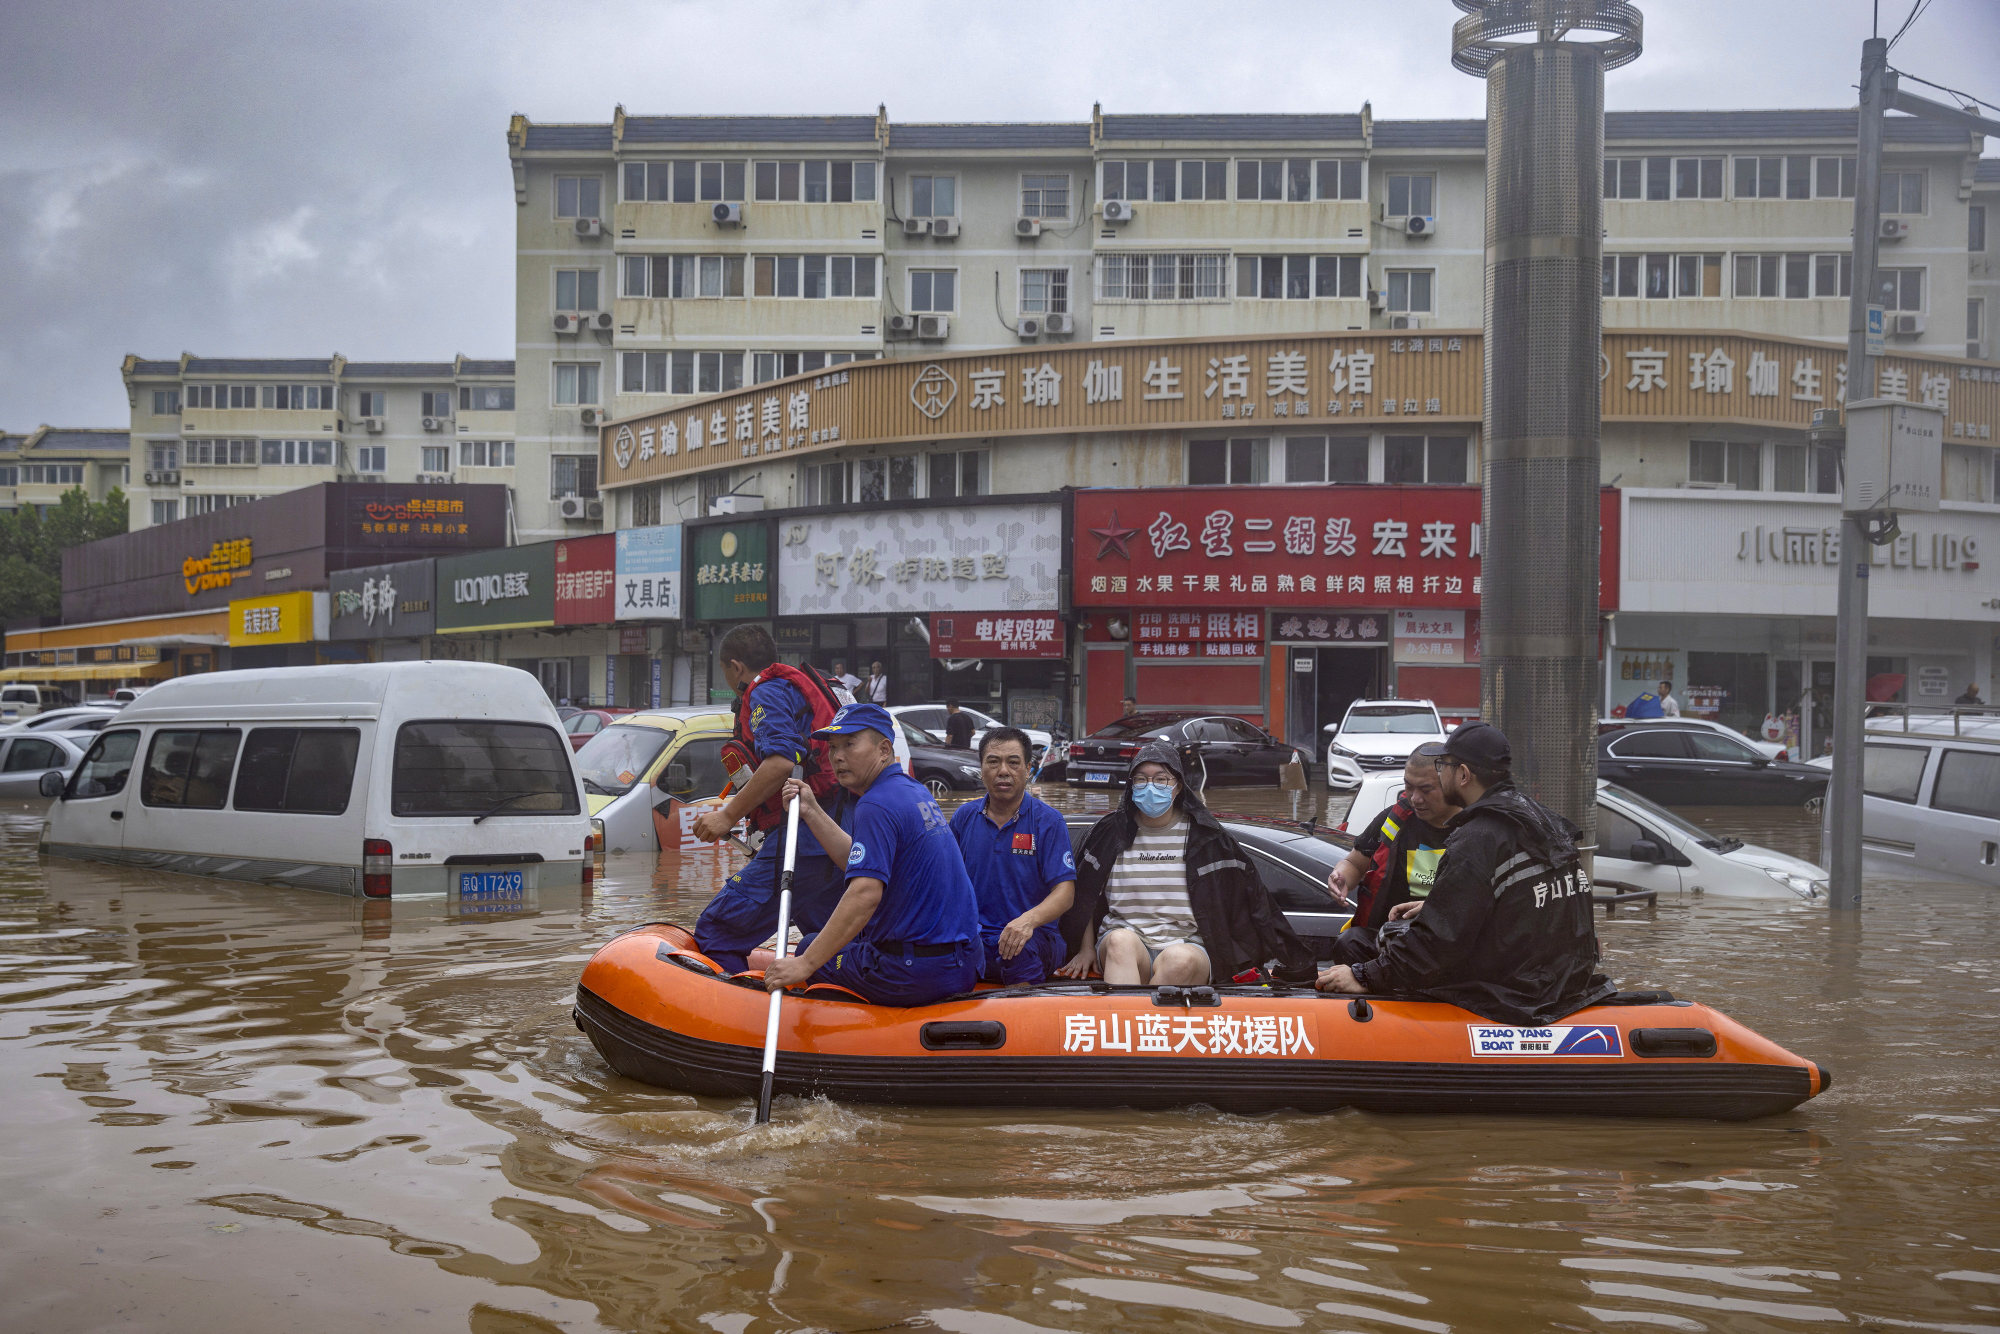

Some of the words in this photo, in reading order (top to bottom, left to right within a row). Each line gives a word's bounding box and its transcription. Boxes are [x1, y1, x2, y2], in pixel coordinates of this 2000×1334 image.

[969, 348, 1375, 411] 京瑜伽生活美馆
[1222, 403, 1256, 418] 理疗
[1273, 401, 1310, 417] 减脂
[1328, 399, 1365, 415] 孕产
[1383, 398, 1441, 414] 普拉提
[638, 390, 811, 461] 京瑜伽生活美馆
[407, 499, 464, 513] 点点超市
[1148, 510, 1357, 559] 红星二锅头
[1372, 518, 1482, 560] 宏来
[624, 577, 671, 608] 文具店
[1091, 575, 1127, 593] 烟酒
[1136, 575, 1173, 593] 水果
[1183, 574, 1220, 593] 干果
[1230, 575, 1268, 593] 礼品
[1277, 574, 1317, 593] 熟食
[1326, 575, 1366, 594] 鲜肉
[1374, 575, 1414, 594] 照相
[1139, 613, 1162, 625] 打印
[1168, 612, 1202, 624] 洗照片
[1206, 612, 1259, 639] 照相
[1279, 616, 1379, 639] 欢迎光临
[1405, 621, 1453, 634] 晨光文具
[976, 618, 1056, 642] 电烤鸡架
[1139, 626, 1162, 638] 复印
[1139, 643, 1190, 656] 手机维修
[1206, 643, 1257, 656] 贴膜回收
[1405, 642, 1454, 656] 办公用品
[1063, 1013, 1315, 1056] 房山蓝天救援队
[1479, 1029, 1514, 1038] ZHAO
[1518, 1029, 1553, 1038] YANG
[1481, 1041, 1514, 1051] BOAT
